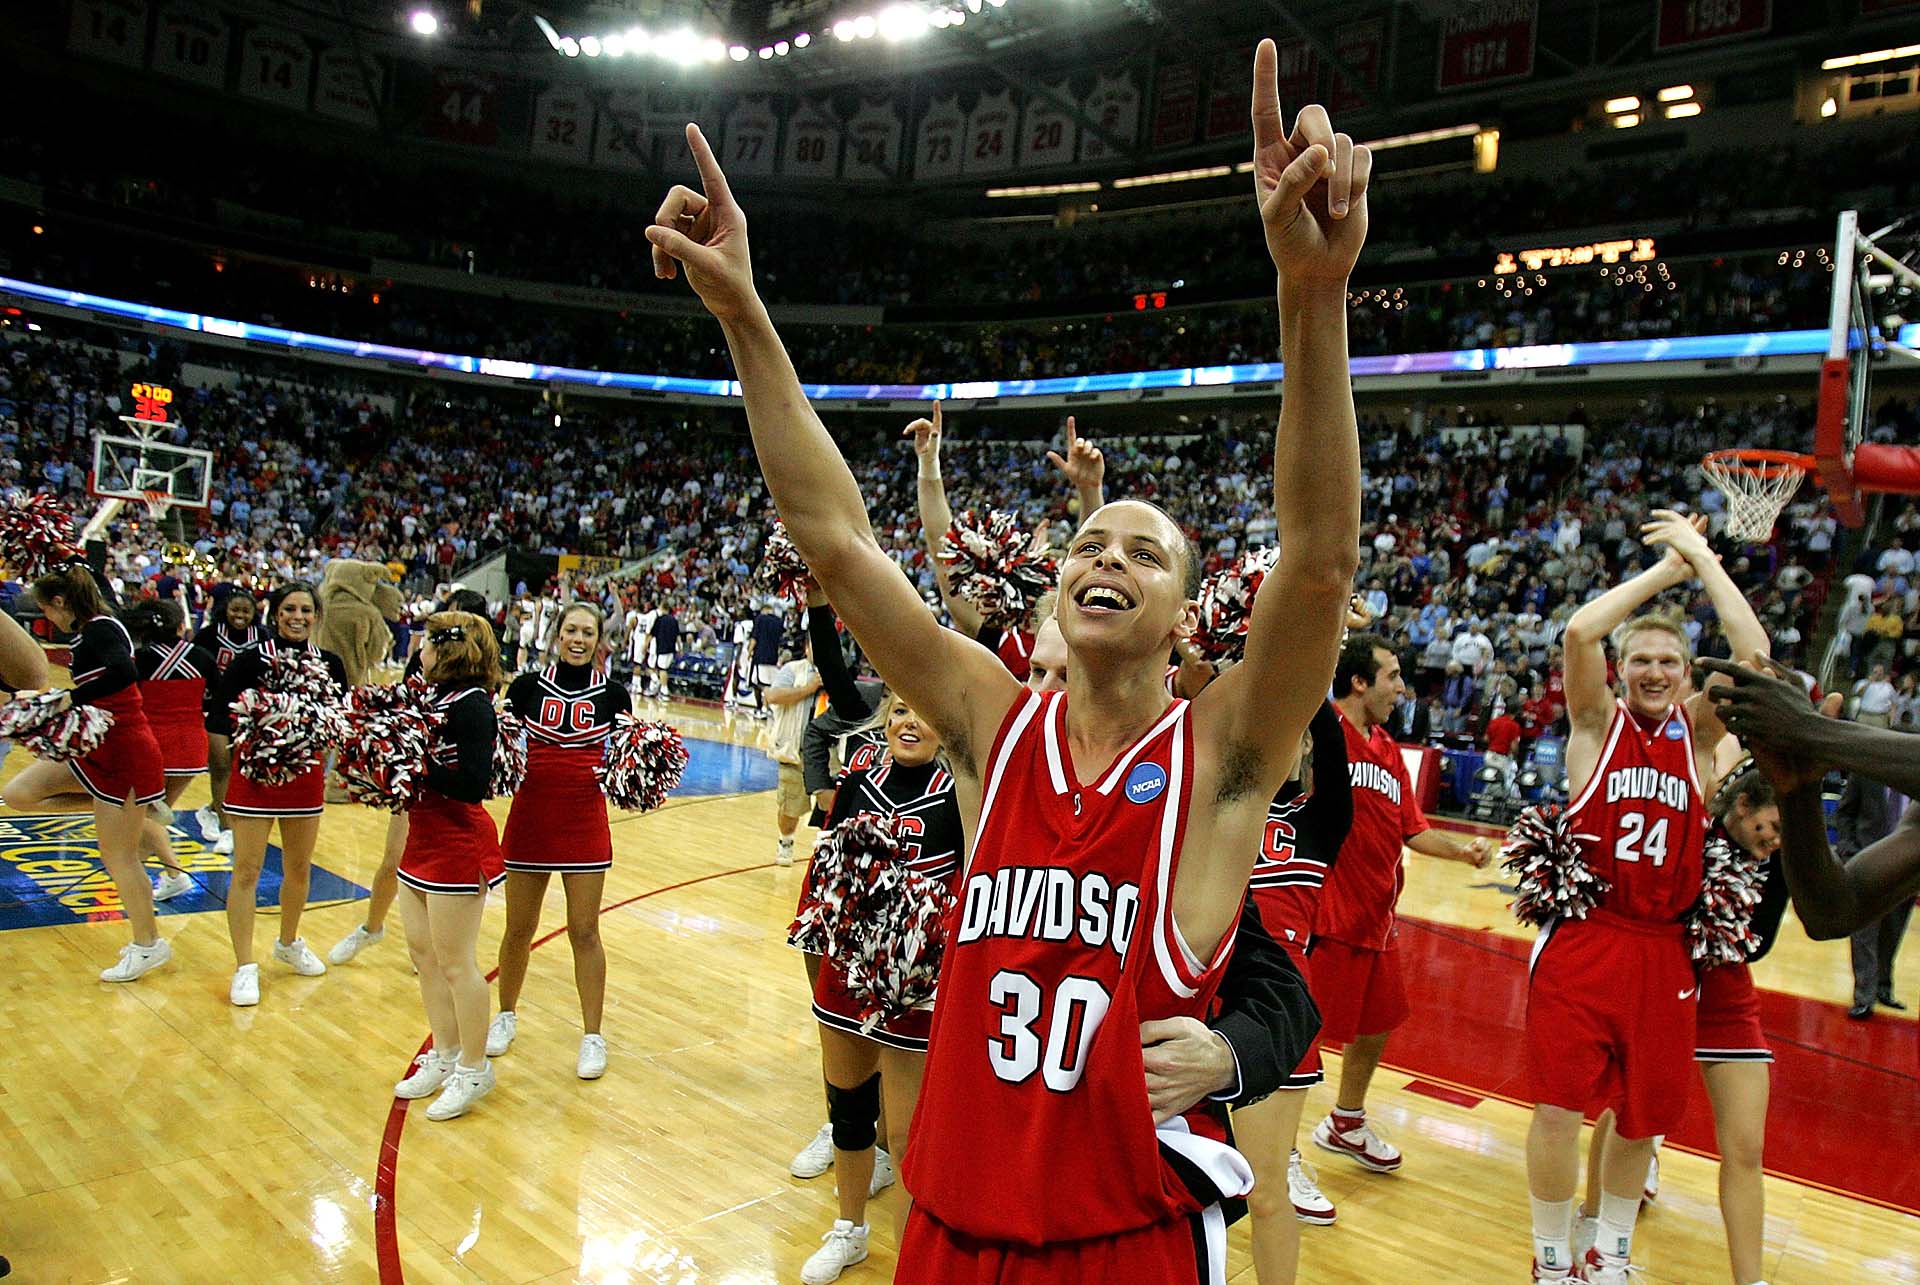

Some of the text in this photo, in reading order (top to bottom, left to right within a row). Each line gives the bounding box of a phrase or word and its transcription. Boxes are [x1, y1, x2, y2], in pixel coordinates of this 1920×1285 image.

[1131, 777, 1162, 795] NCAA
[1606, 766, 1690, 812] DAVIDSON
[1614, 811, 1669, 867] 24
[957, 866, 1140, 971] DAVIDSO
[987, 968, 1112, 1095] 30
